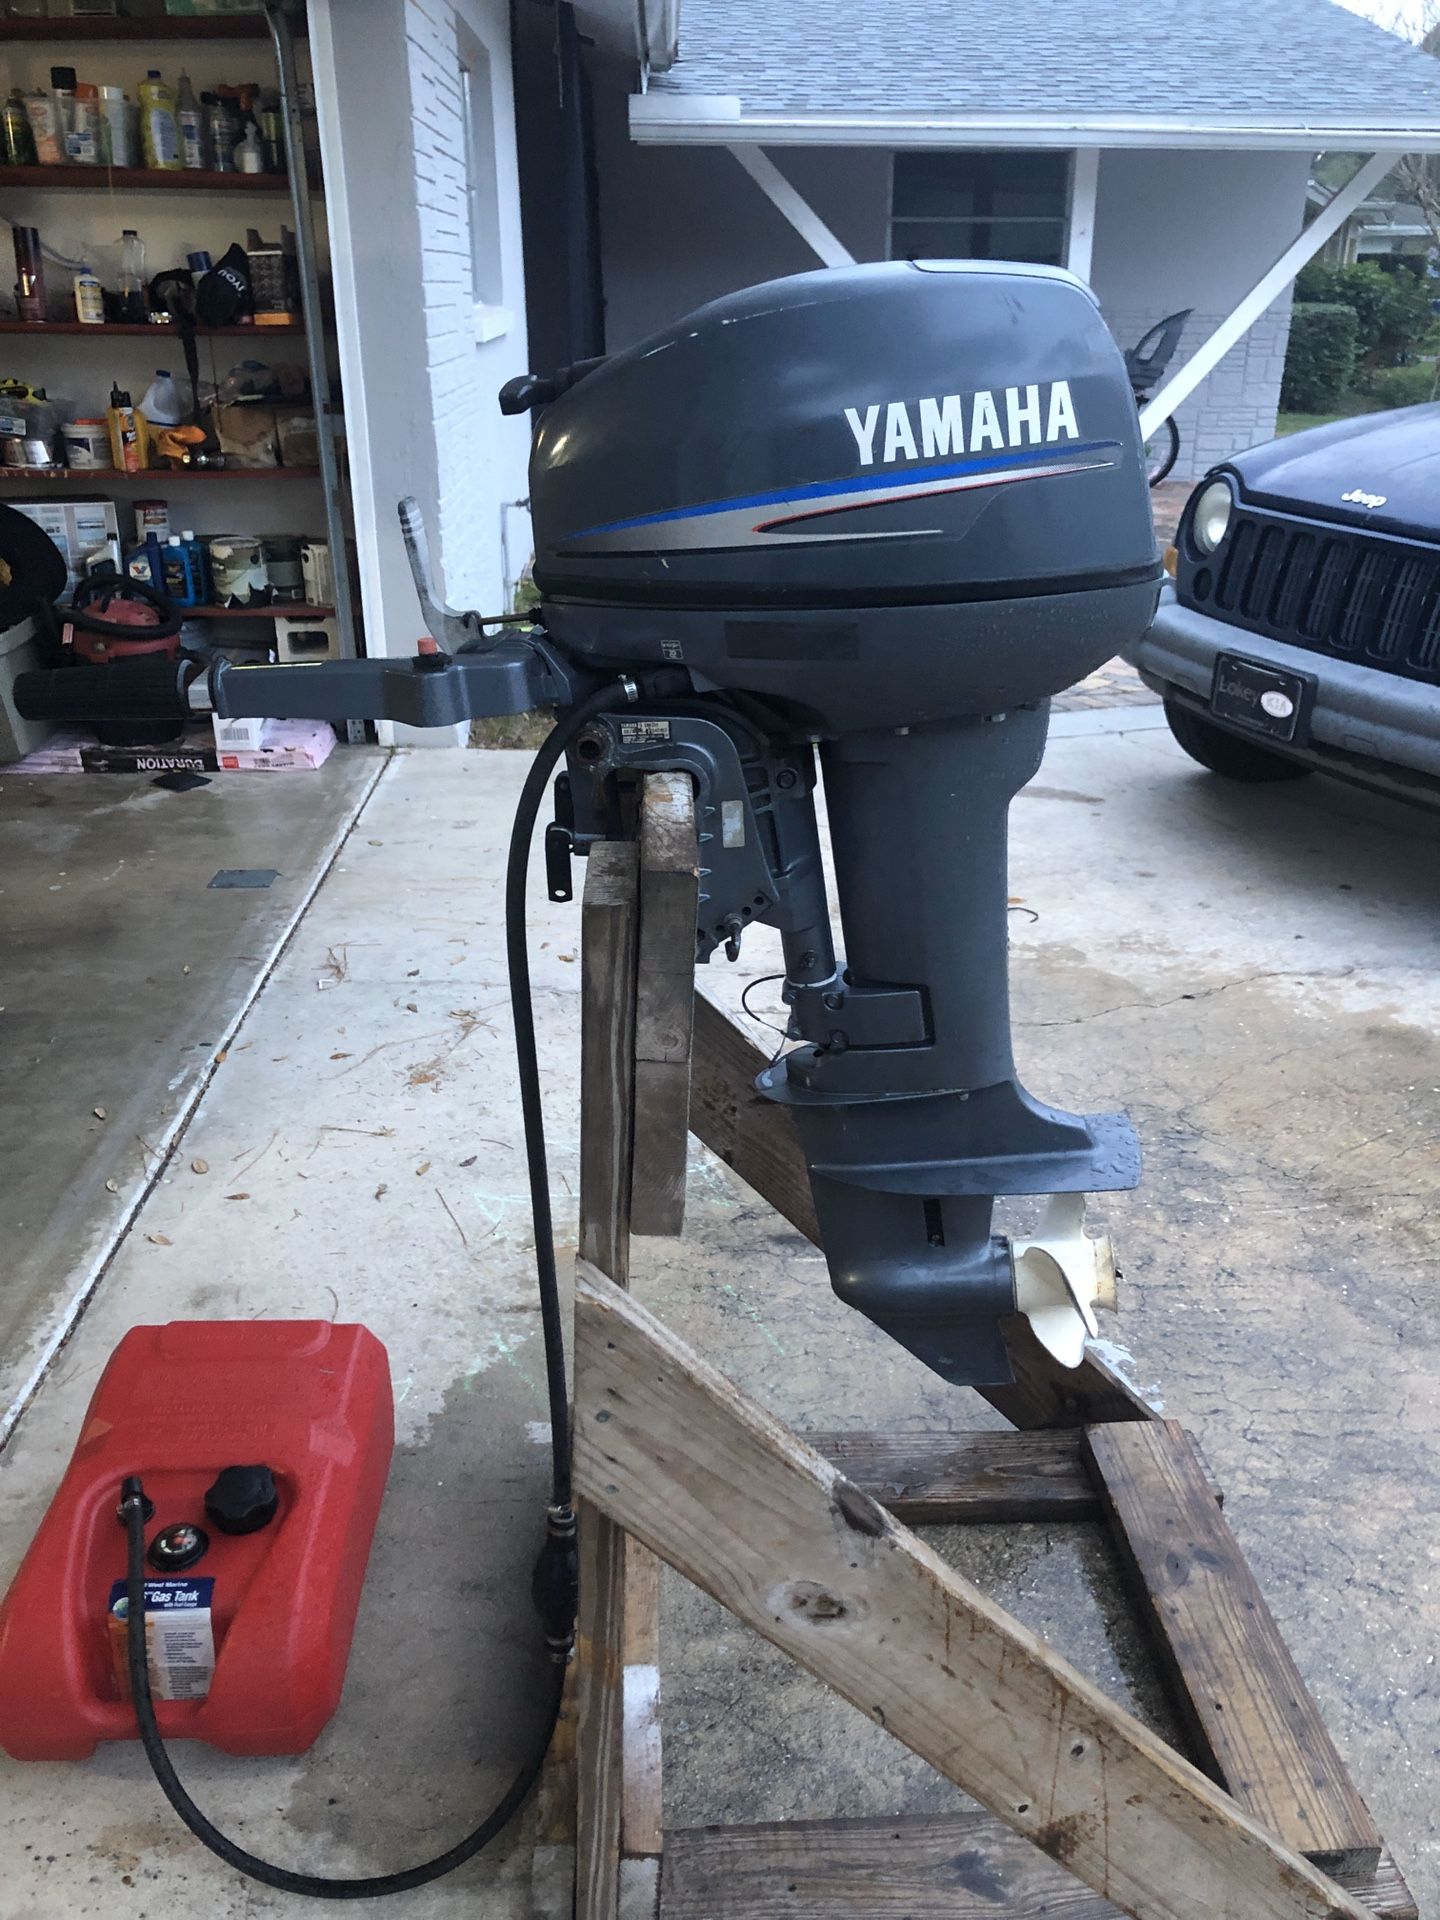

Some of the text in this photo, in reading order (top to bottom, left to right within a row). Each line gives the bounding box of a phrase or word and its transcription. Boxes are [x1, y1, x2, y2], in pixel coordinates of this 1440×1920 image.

[844, 380, 1080, 466] YAMAHA
[1341, 488, 1387, 509] Jeep
[1218, 674, 1260, 708] Lokey
[151, 1590, 172, 1602] Gas
[174, 1590, 199, 1602] Tank
